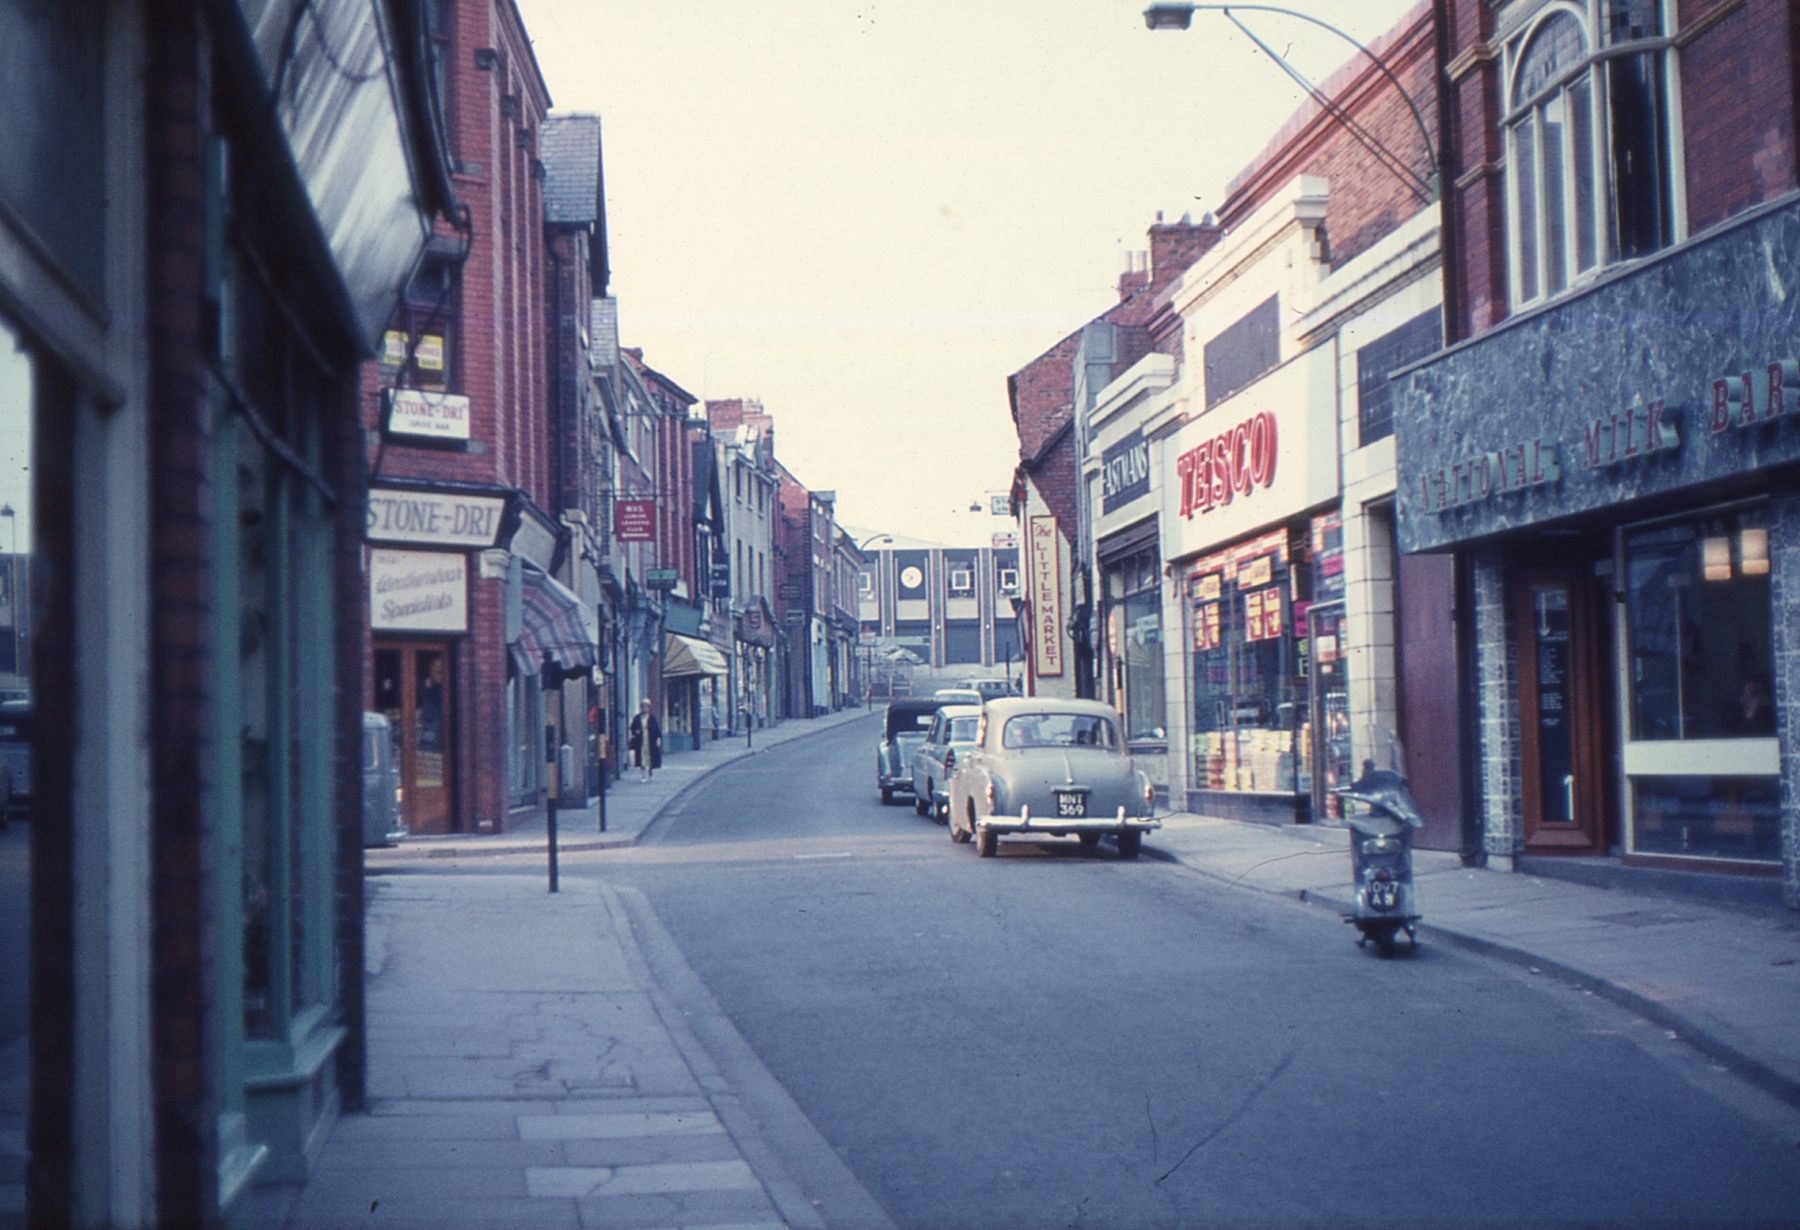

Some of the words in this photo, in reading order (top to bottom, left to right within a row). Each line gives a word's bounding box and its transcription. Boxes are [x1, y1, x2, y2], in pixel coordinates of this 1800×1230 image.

[394, 399, 464, 421] STONE-DRI
[1420, 438, 1547, 515] NATIONAL
[1582, 400, 1666, 471] MILK
[1711, 357, 1800, 434] BAR
[1177, 411, 1278, 520] TESCO
[366, 498, 493, 536] STONE-DRI
[1035, 523, 1052, 537] The
[1036, 541, 1052, 601] LITTLE
[1041, 605, 1057, 665] MARKET
[1059, 804, 1085, 816] 369
